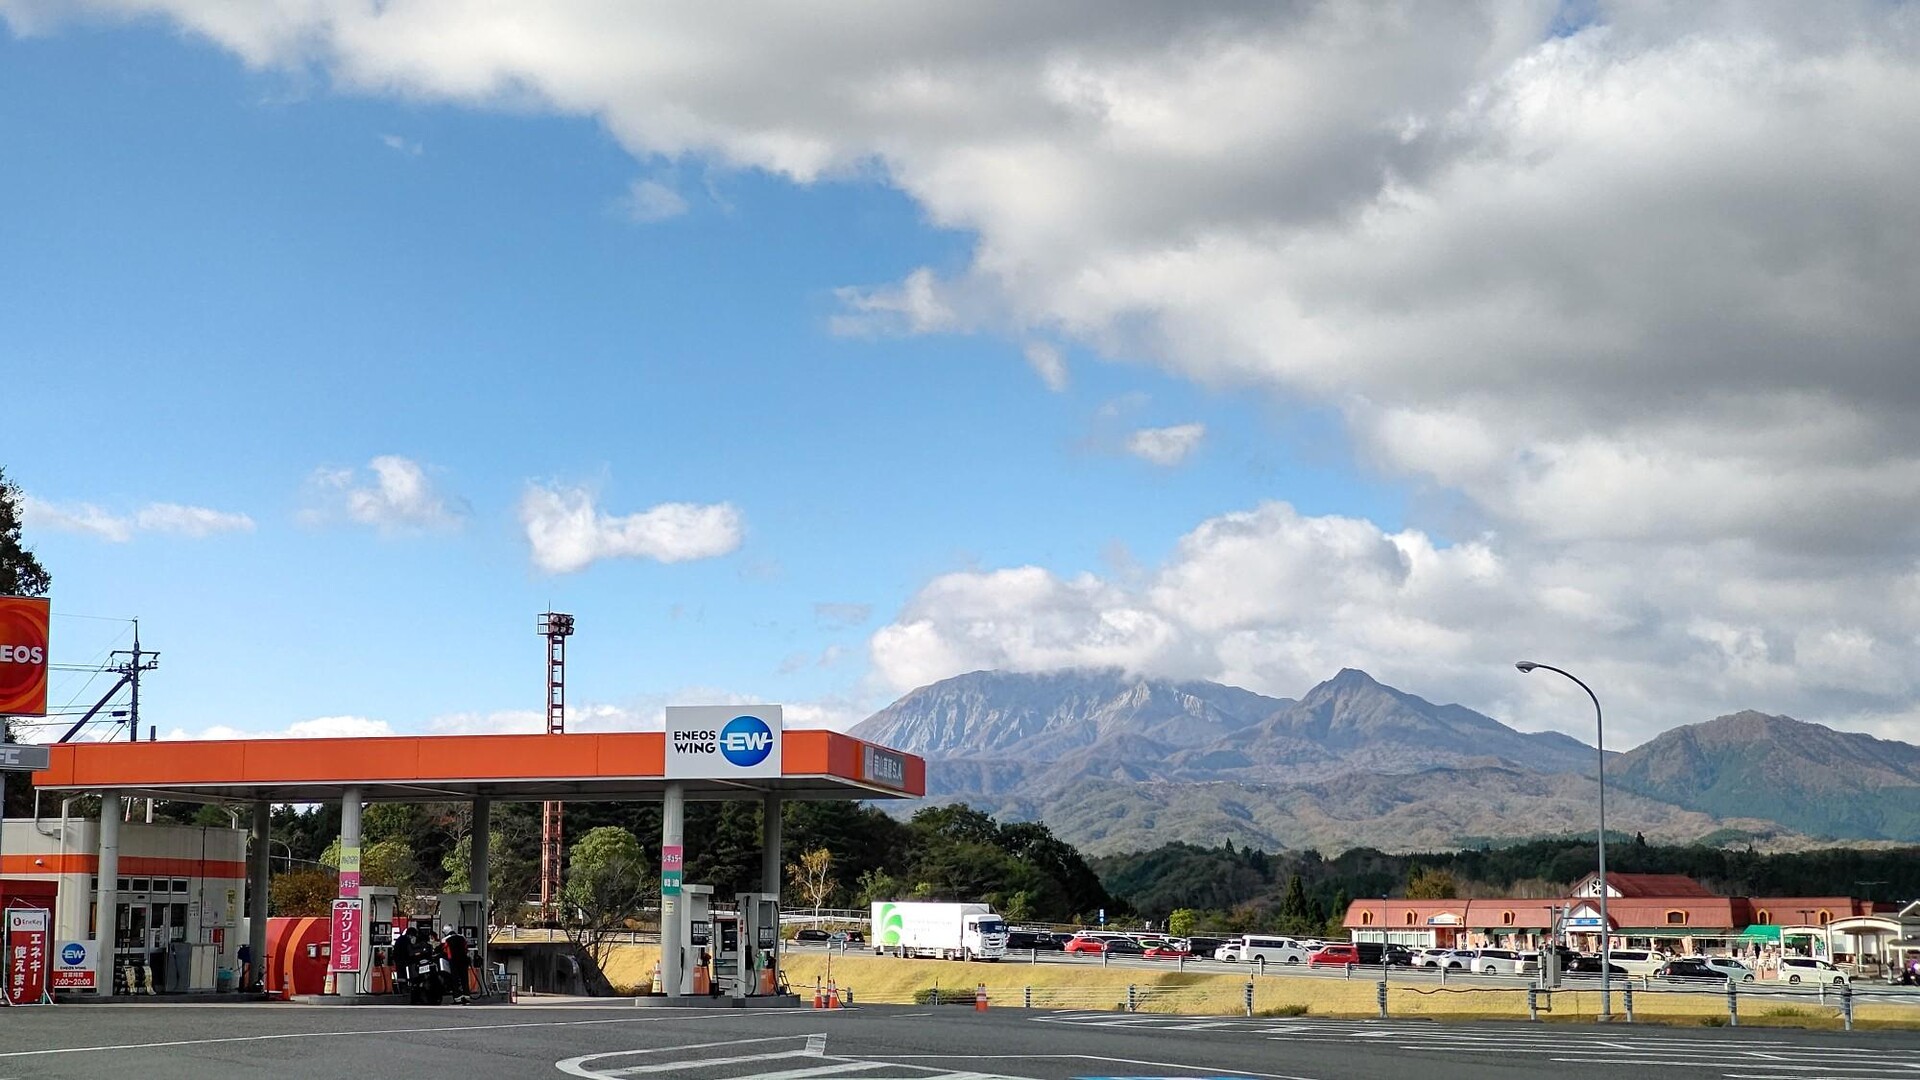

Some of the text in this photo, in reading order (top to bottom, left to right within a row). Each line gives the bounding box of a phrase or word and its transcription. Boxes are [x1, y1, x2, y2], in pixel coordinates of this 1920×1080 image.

[0, 645, 43, 664] EOS
[673, 730, 716, 741] ENEOS
[726, 731, 769, 751] EW
[674, 742, 716, 754] WING
[340, 910, 353, 965] ガソリン車
[30, 933, 42, 986] エネキー
[13, 946, 27, 999] 使えます
